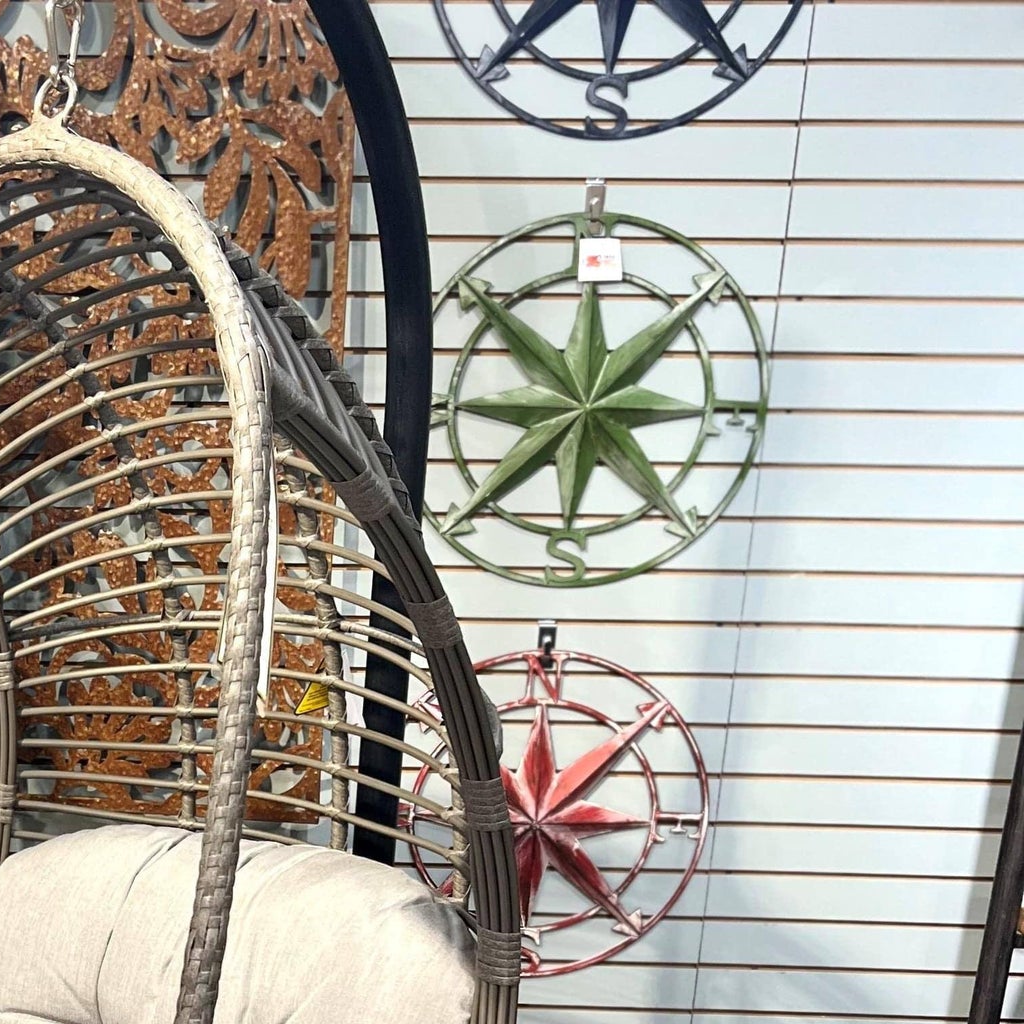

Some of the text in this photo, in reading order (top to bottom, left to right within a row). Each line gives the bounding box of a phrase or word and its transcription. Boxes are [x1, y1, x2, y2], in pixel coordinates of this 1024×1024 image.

[584, 76, 628, 139] S
[544, 529, 588, 587] S
[518, 652, 570, 704] N
